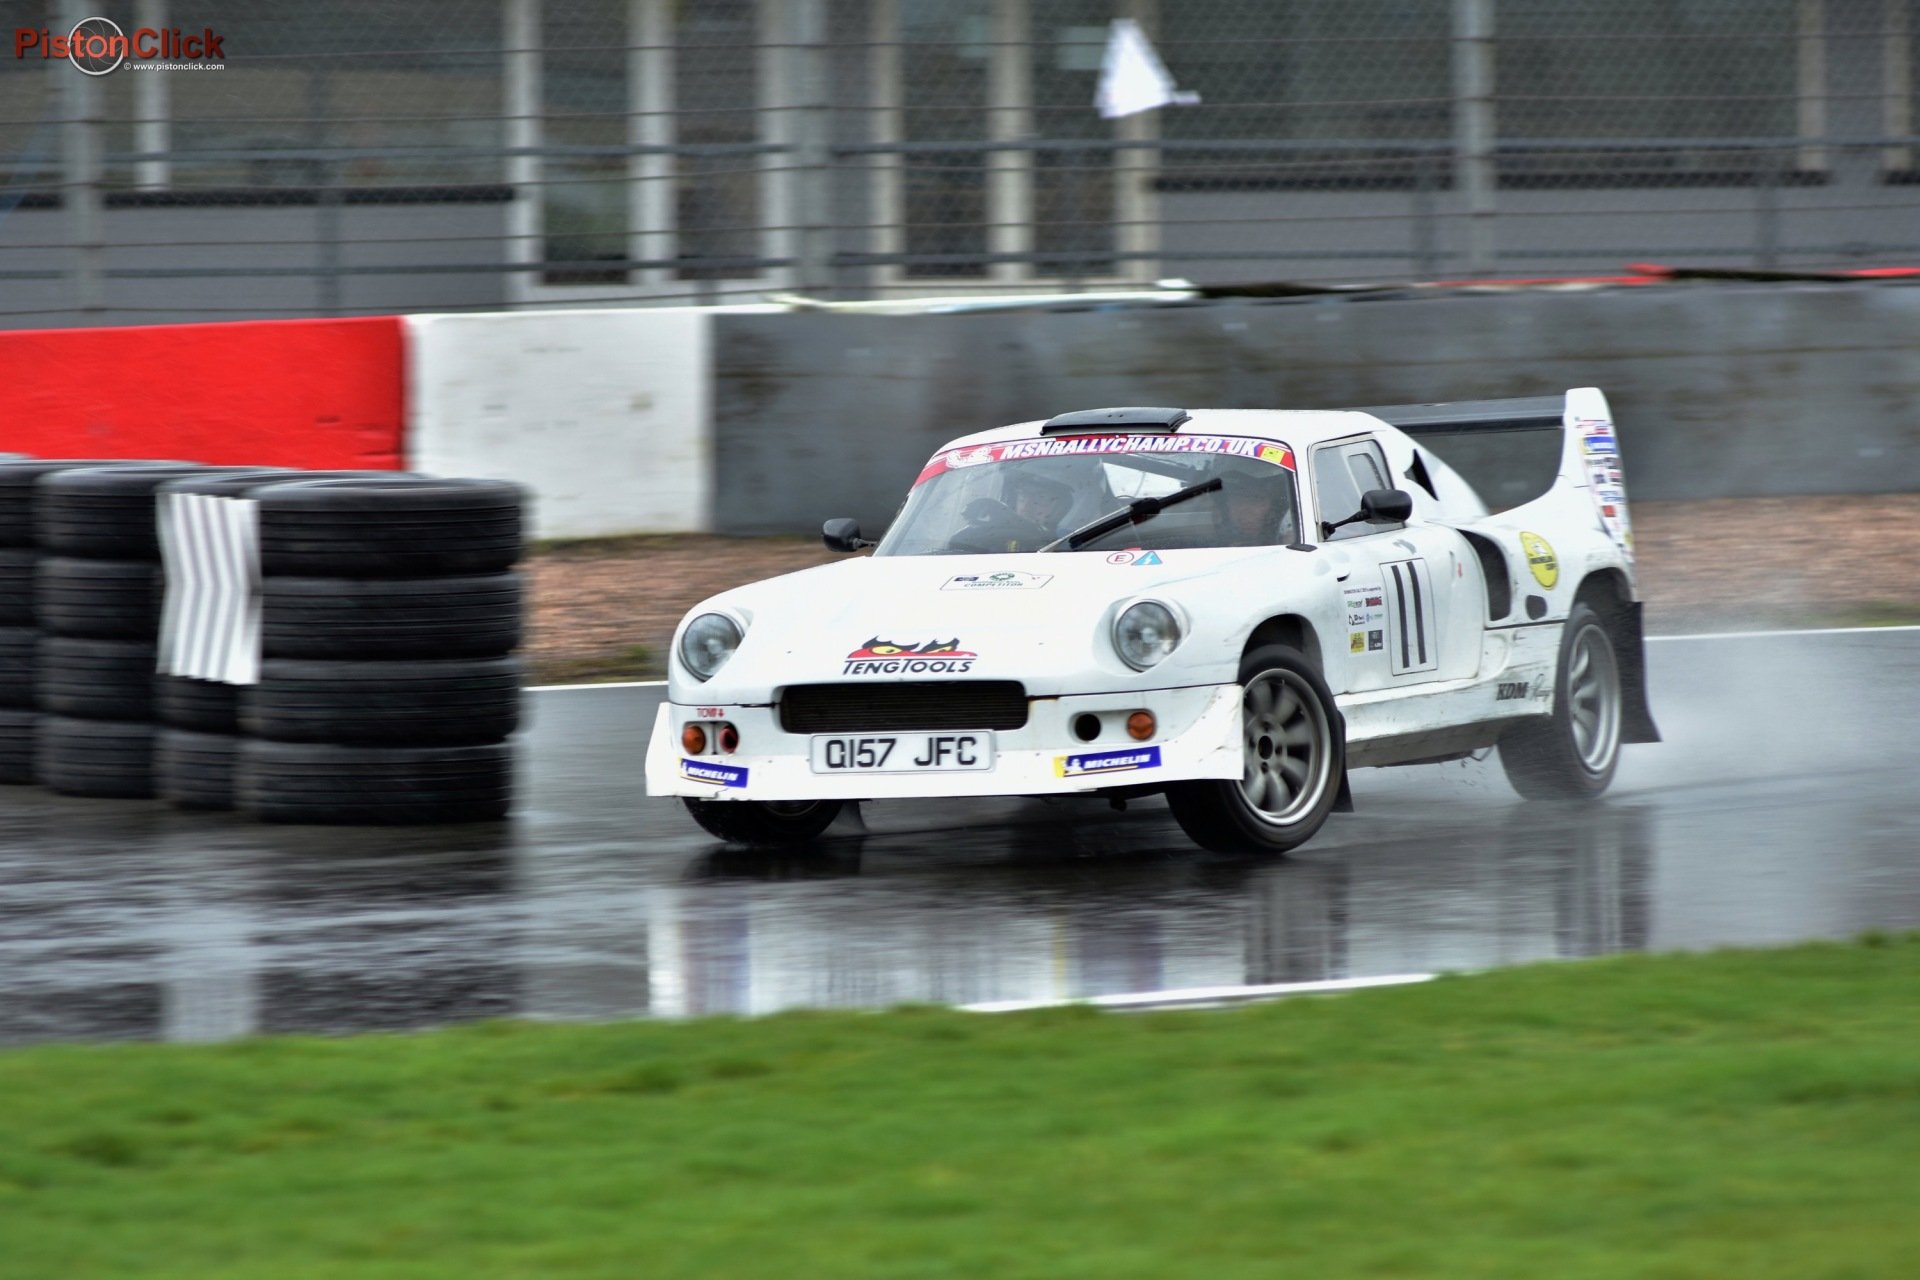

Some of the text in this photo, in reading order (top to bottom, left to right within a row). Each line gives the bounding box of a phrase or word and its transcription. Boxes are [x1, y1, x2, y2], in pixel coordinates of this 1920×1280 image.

[1000, 436, 1256, 459] MSNRALLYCHAMP.CO.UK
[1391, 561, 1427, 669] 11
[826, 736, 977, 768] Q157 JFC
[1083, 754, 1151, 769] MICHELIN
[687, 767, 739, 781] MICHELIN
